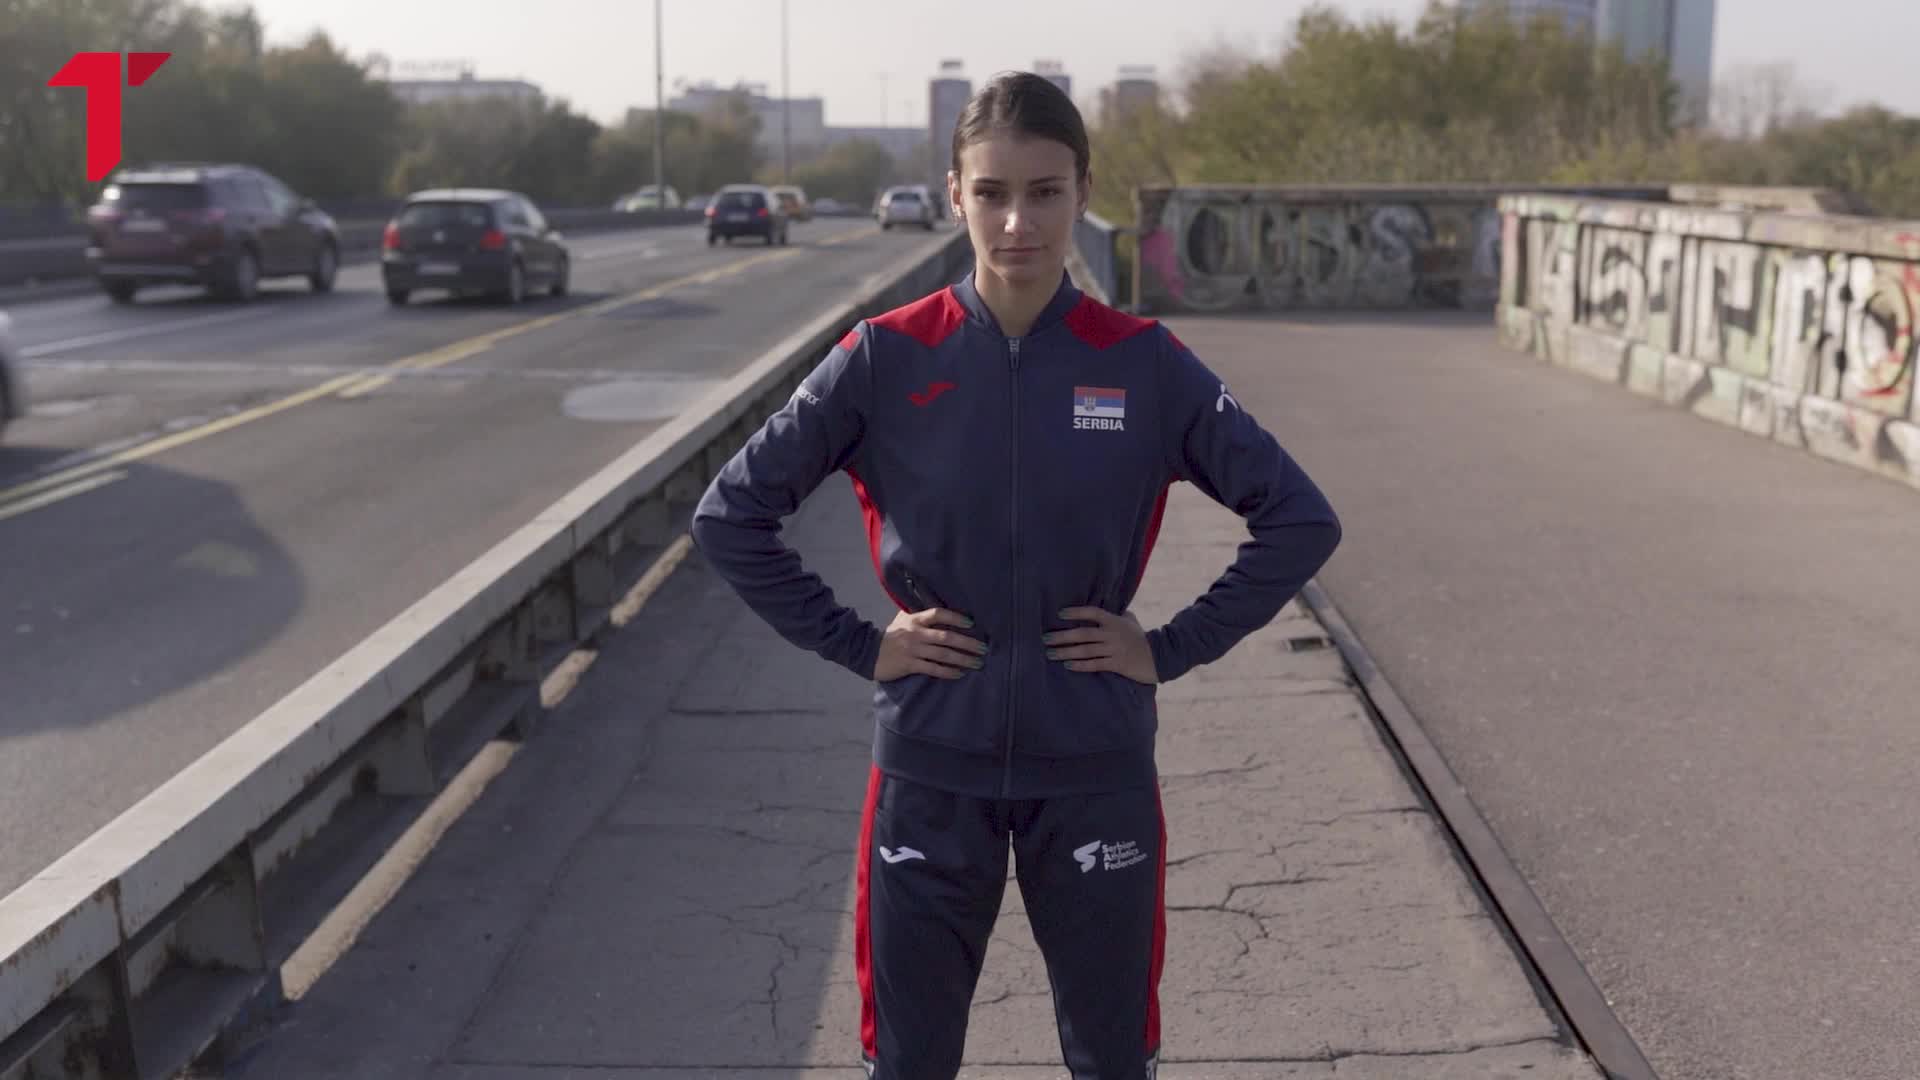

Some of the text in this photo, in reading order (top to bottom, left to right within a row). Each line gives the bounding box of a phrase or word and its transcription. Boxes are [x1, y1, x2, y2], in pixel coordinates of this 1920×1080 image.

[1073, 417, 1125, 431] SERBIA
[1102, 841, 1136, 854] Serbian
[1103, 847, 1139, 861] Athletics
[1104, 853, 1148, 871] Federation
